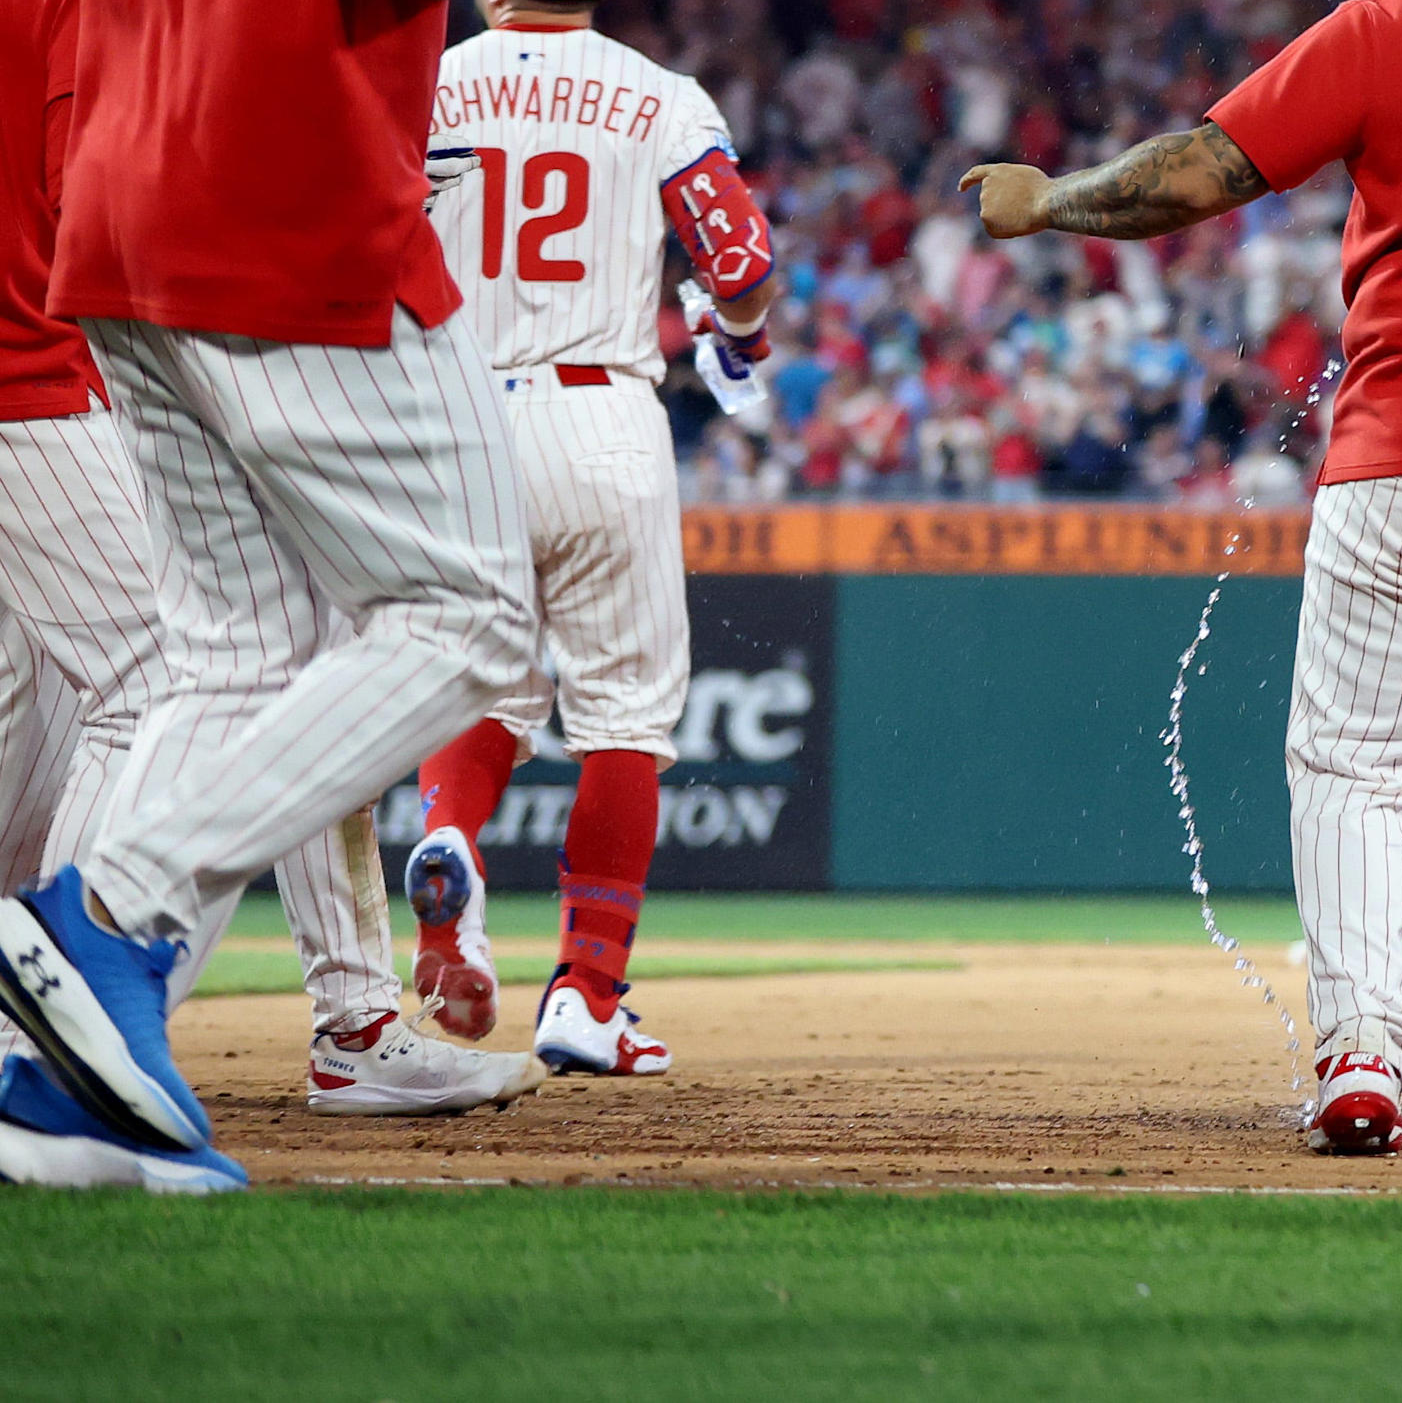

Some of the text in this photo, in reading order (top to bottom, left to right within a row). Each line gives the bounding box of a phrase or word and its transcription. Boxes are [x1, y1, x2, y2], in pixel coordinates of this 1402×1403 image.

[428, 74, 661, 142] CHWARBER
[473, 147, 590, 283] 12
[1346, 1052, 1378, 1067] NIKE
